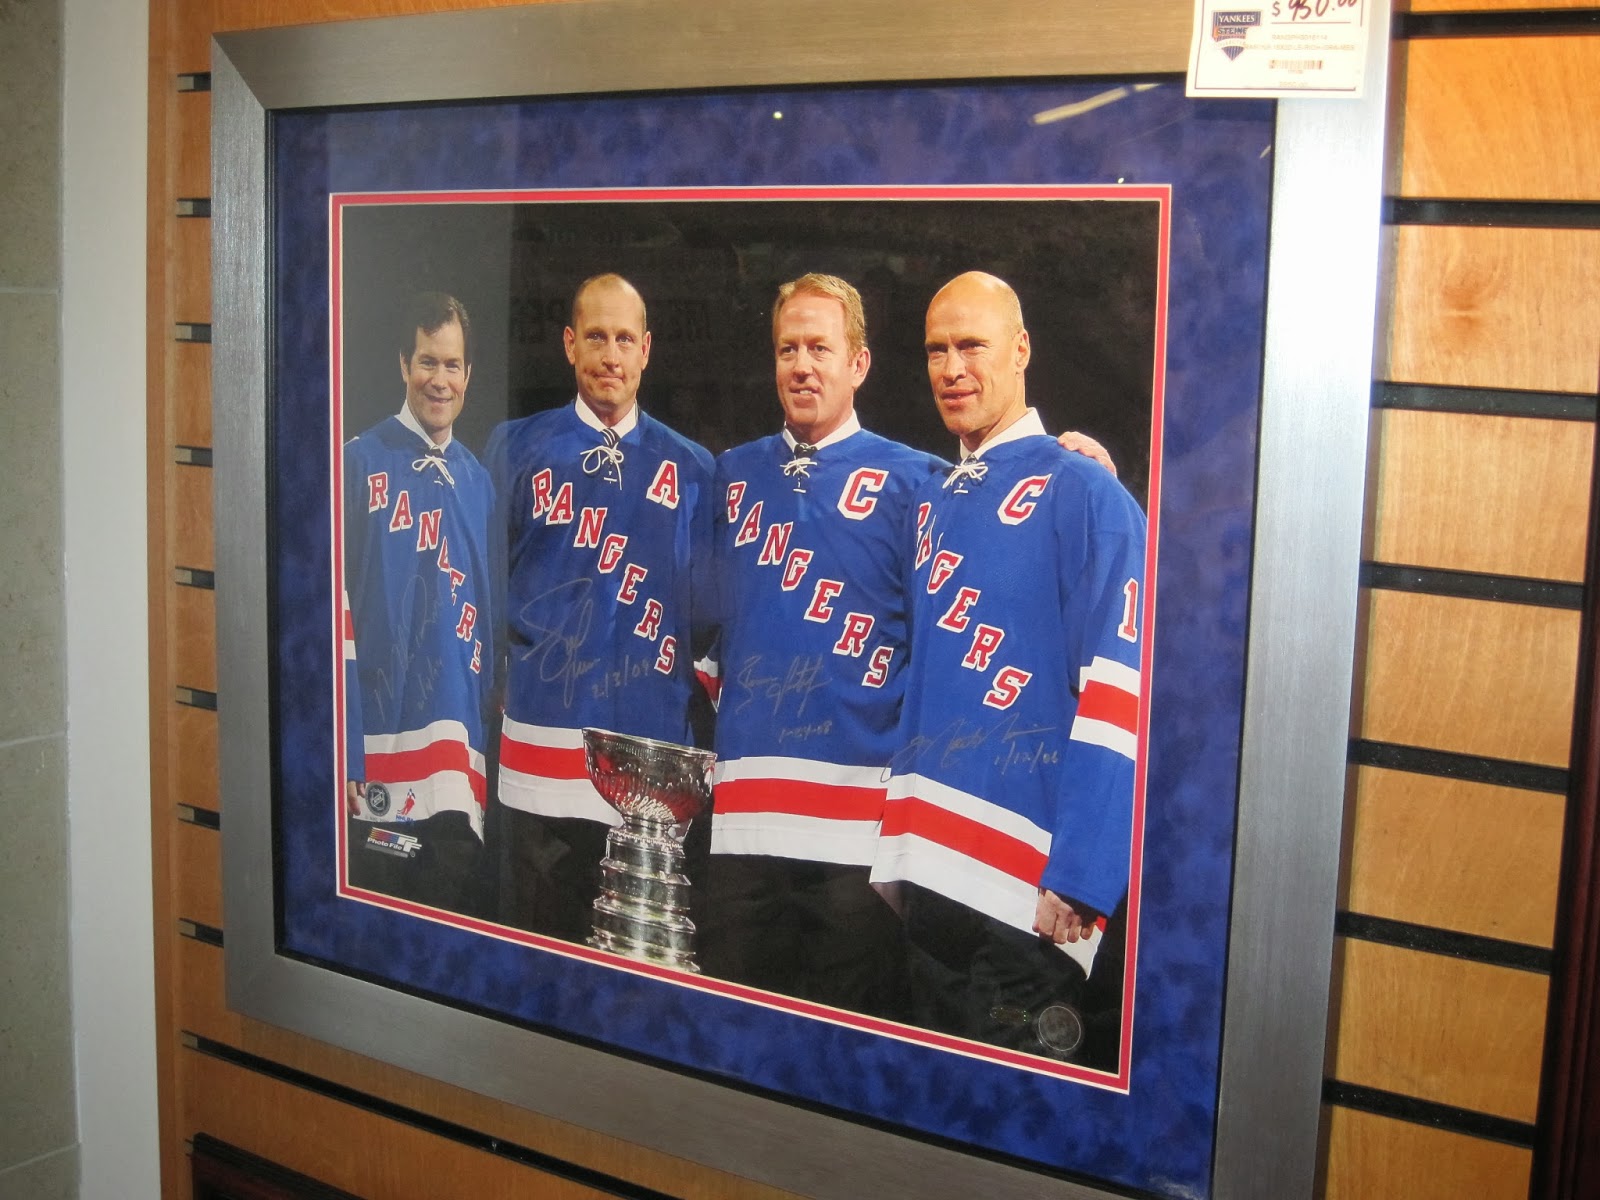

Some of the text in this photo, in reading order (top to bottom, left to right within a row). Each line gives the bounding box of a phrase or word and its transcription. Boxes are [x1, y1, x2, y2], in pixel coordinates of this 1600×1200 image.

[1218, 14, 1255, 23] YANKEES
[1272, 1, 1281, 17] $
[646, 460, 679, 509] A
[837, 467, 889, 520] C
[997, 473, 1052, 526] C
[533, 468, 677, 675] RANGERS
[726, 481, 894, 688] RANGERS
[367, 837, 389, 846] Photo
[389, 842, 403, 851] File
